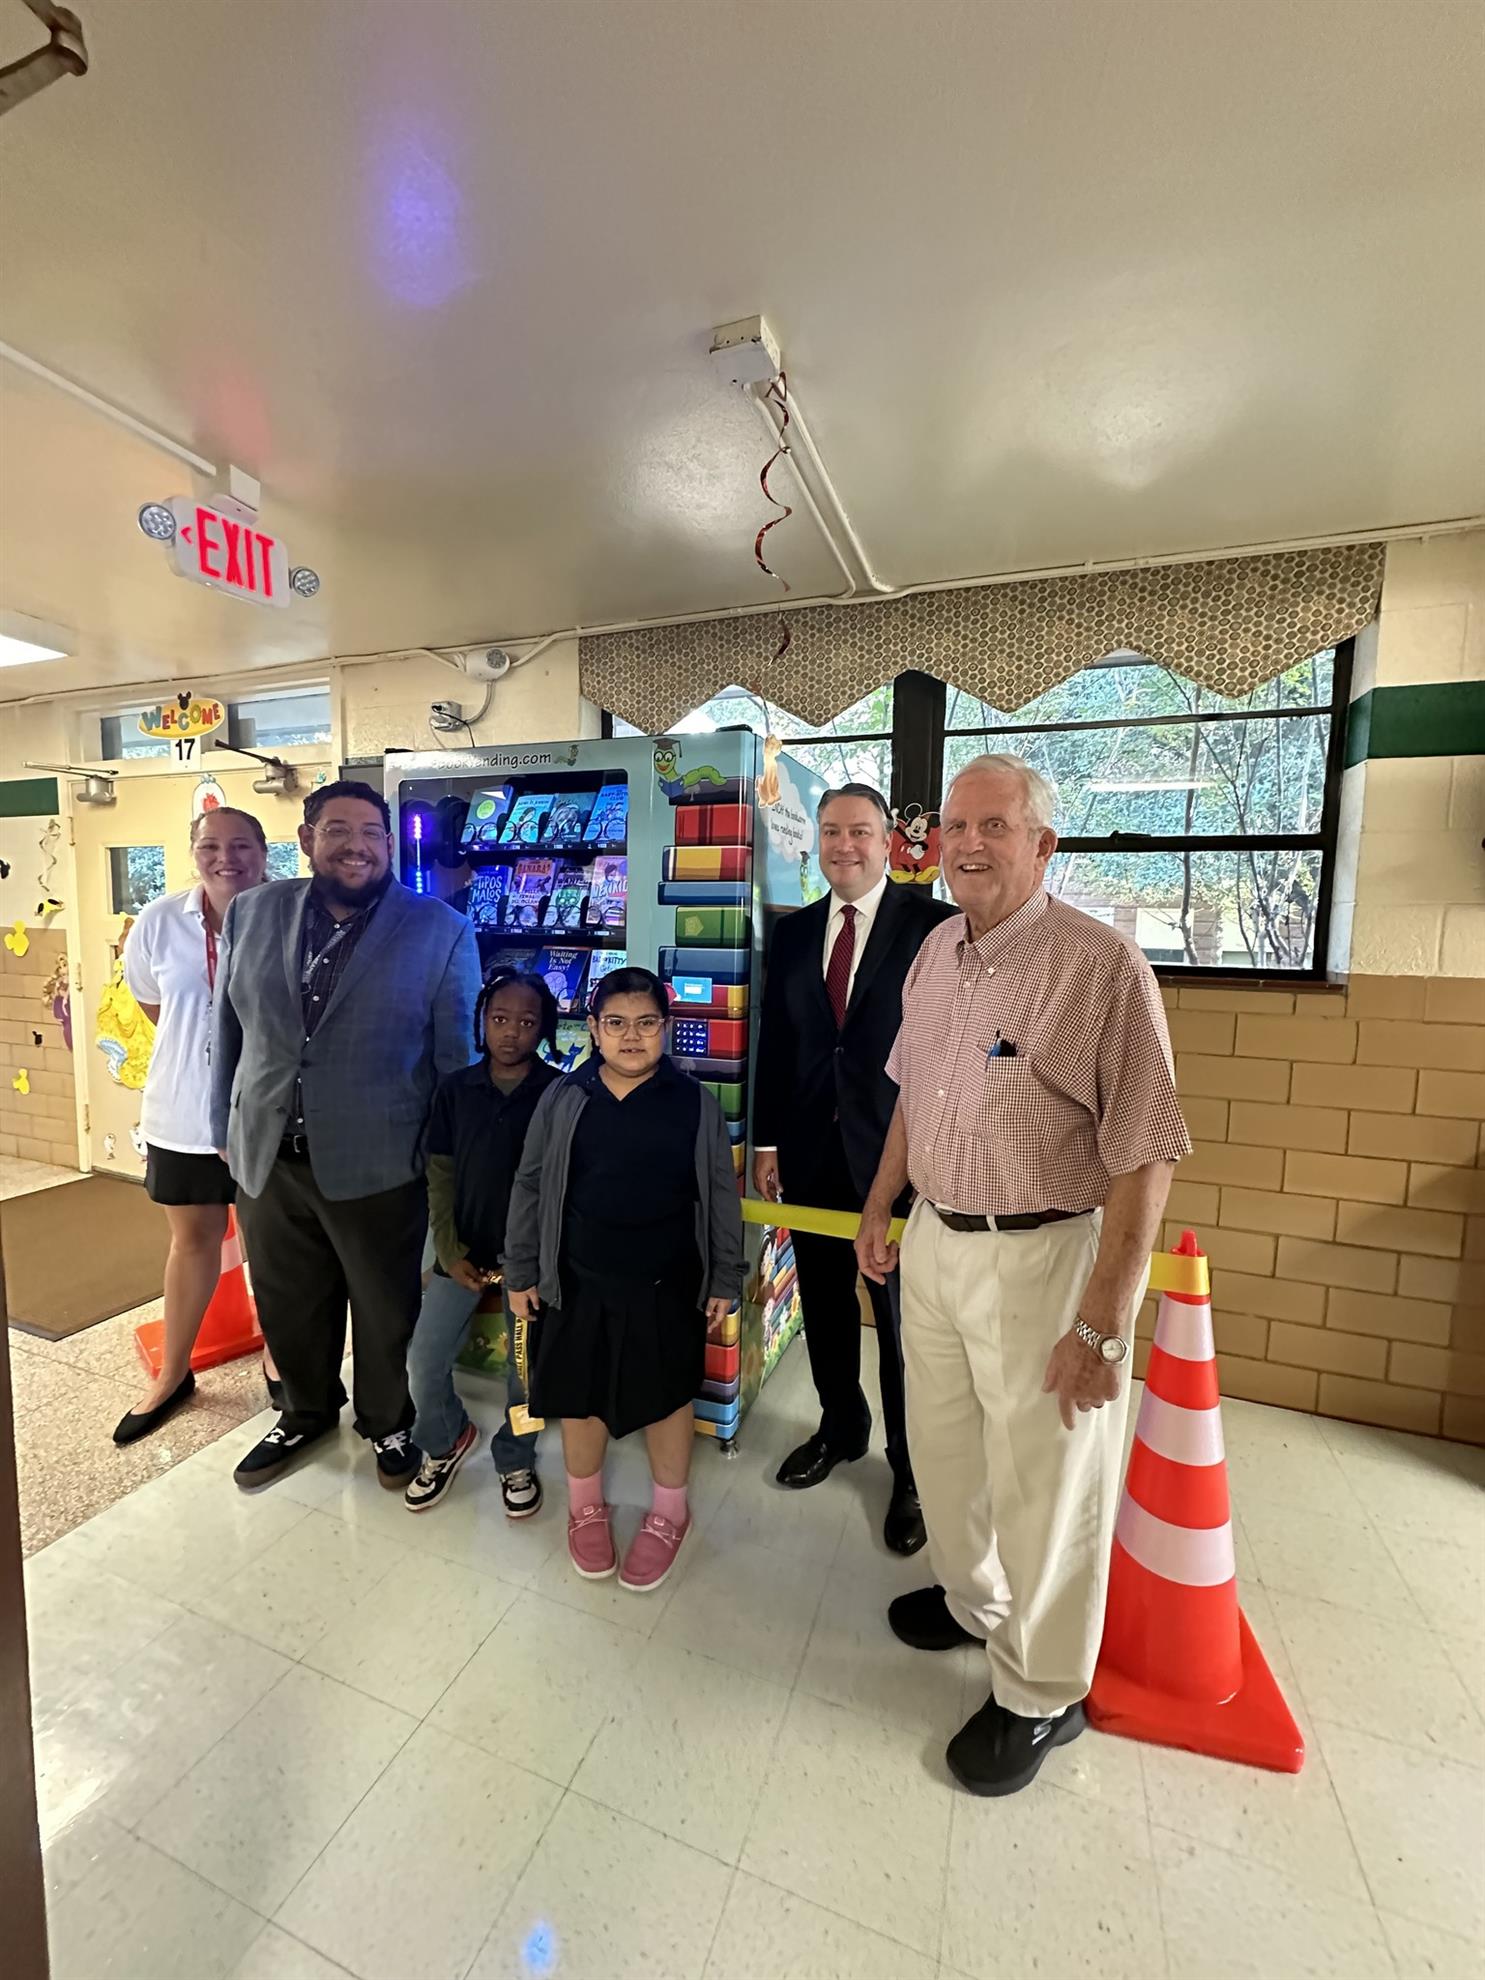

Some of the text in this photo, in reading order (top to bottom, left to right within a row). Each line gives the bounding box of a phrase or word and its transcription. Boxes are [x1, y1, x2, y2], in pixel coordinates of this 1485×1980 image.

[196, 506, 275, 598] EXIT
[141, 702, 221, 731] WELCOME
[175, 738, 195, 761] 17
[549, 950, 578, 960] Waiting
[548, 963, 570, 971] Easy!
